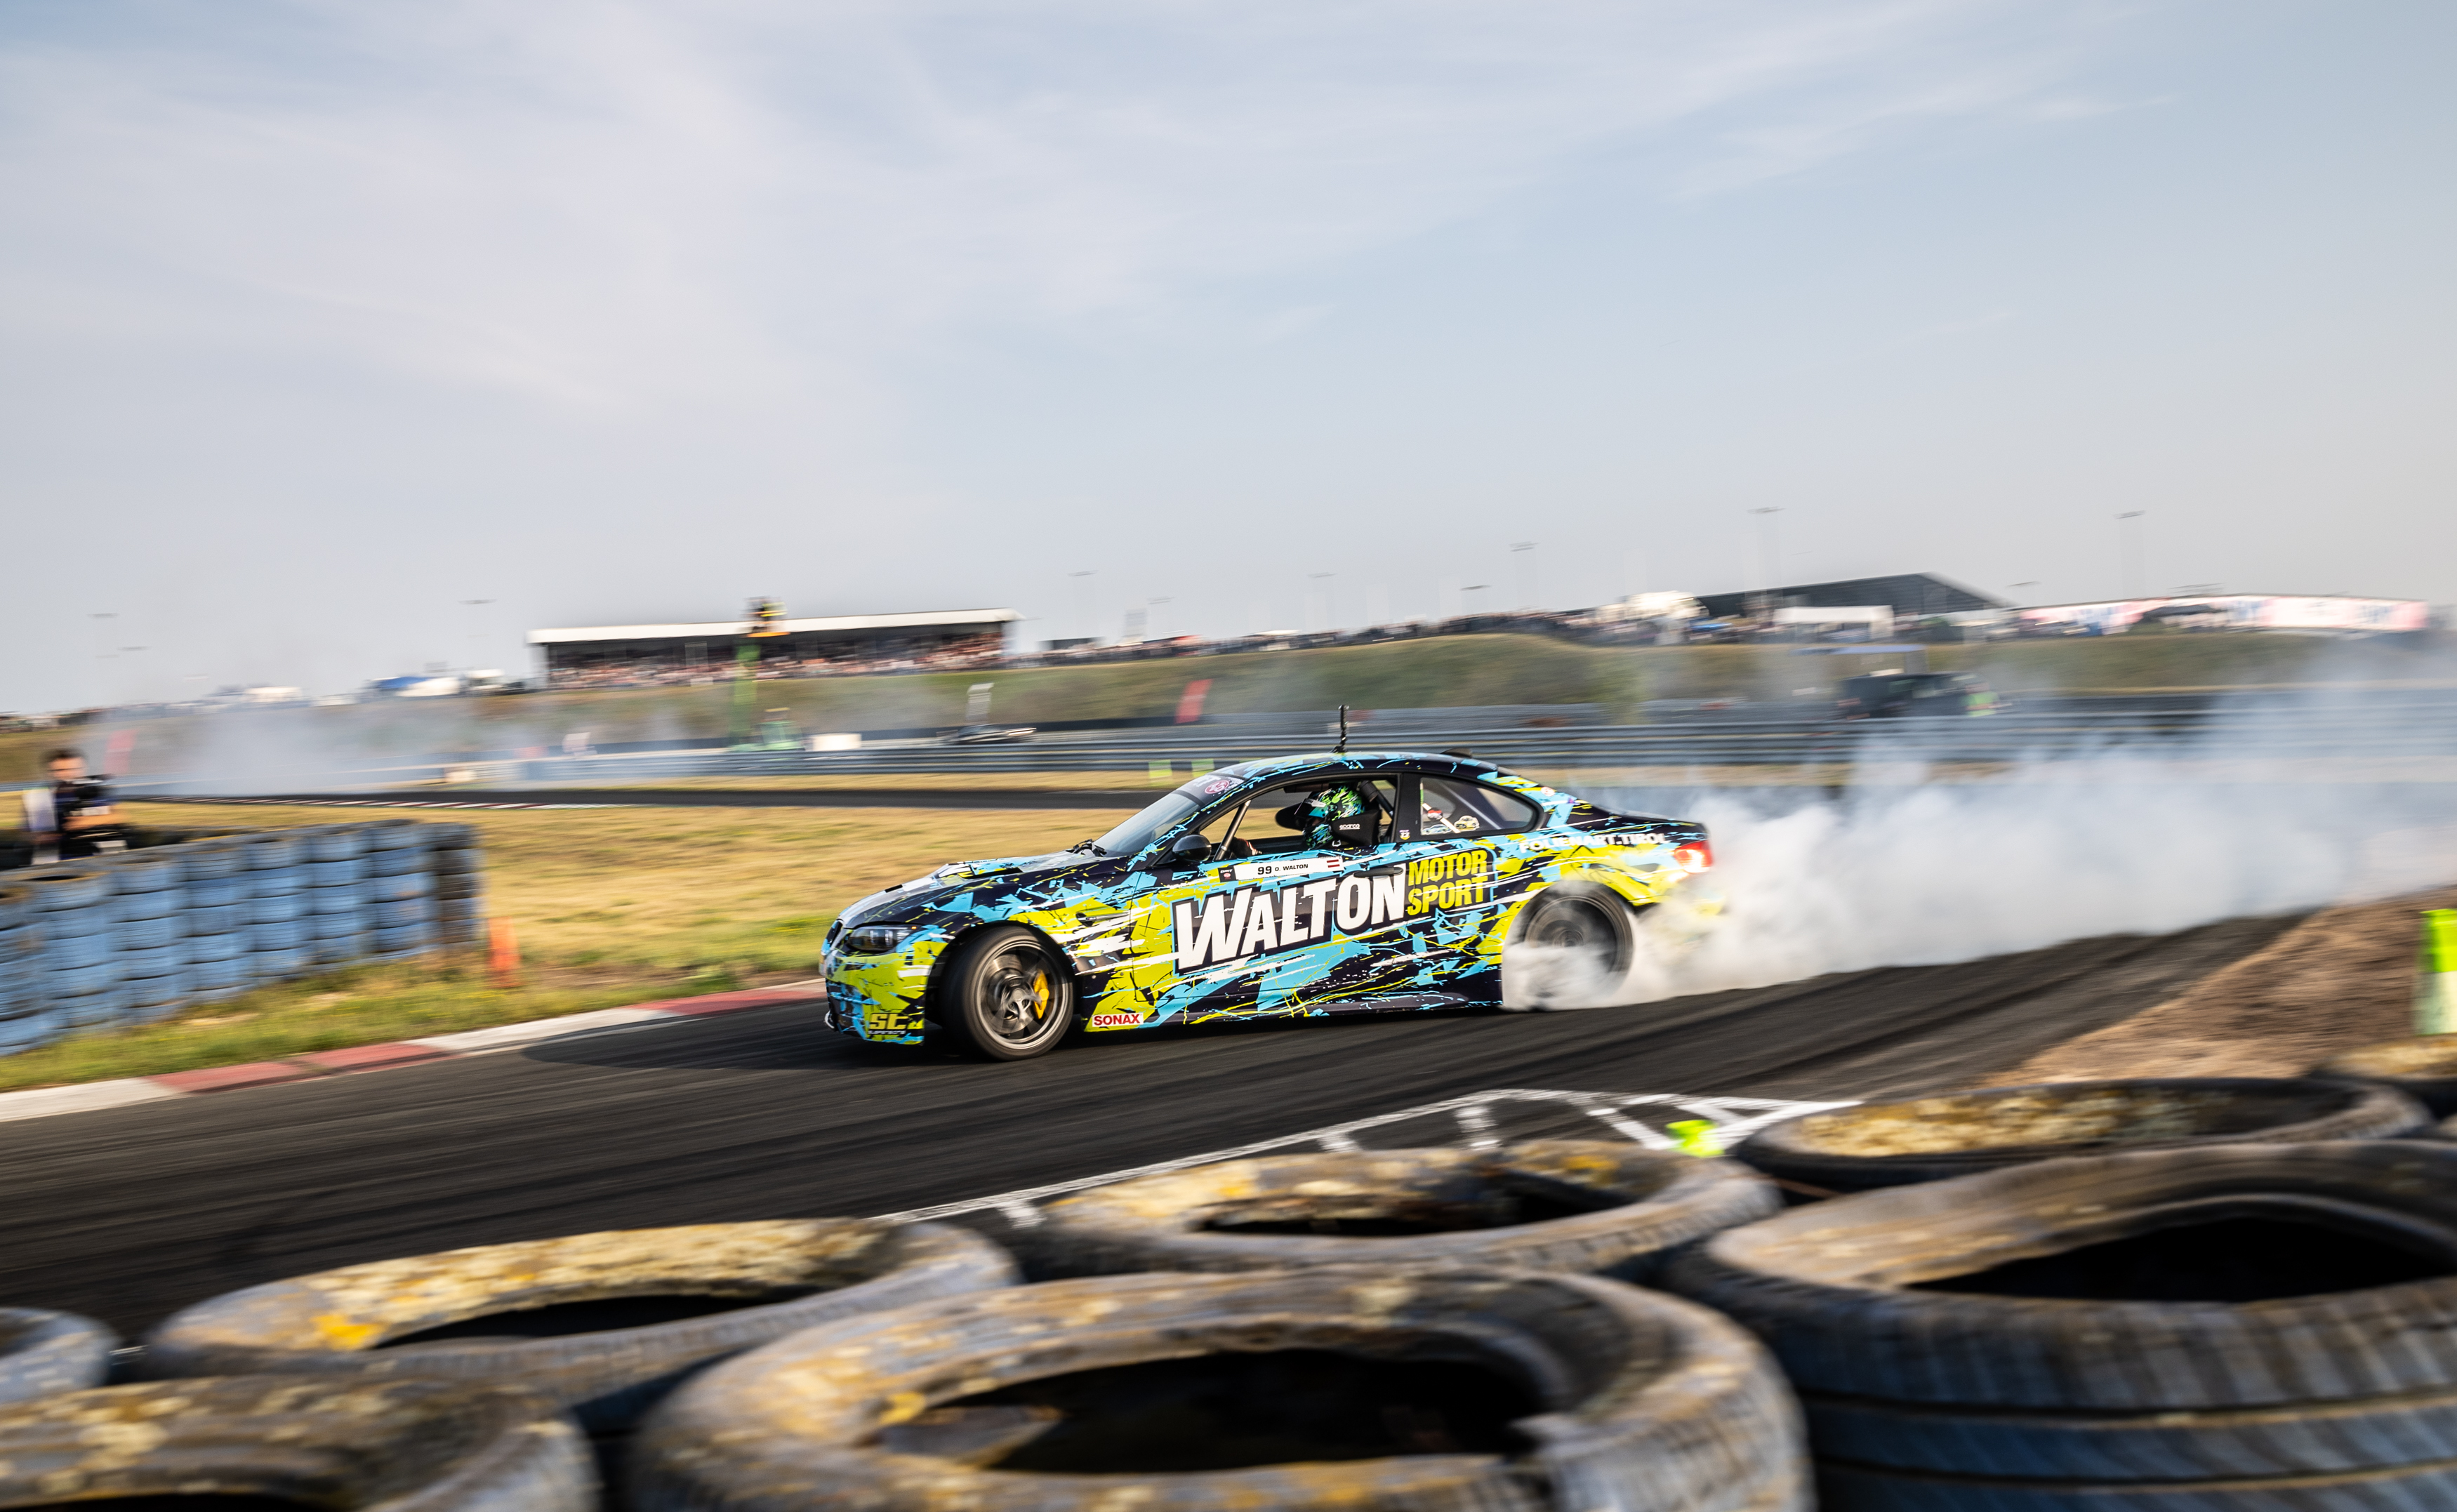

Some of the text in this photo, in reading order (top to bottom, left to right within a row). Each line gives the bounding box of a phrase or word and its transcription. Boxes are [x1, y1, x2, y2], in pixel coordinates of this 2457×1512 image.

[1519, 833, 1671, 854] FOLIENART.TIROL
[1257, 866, 1272, 875] 99
[1408, 850, 1488, 886] MOTOR
[1407, 876, 1487, 915] SPORT
[1174, 863, 1406, 970] WALTON
[1094, 1014, 1141, 1026] SONAX
